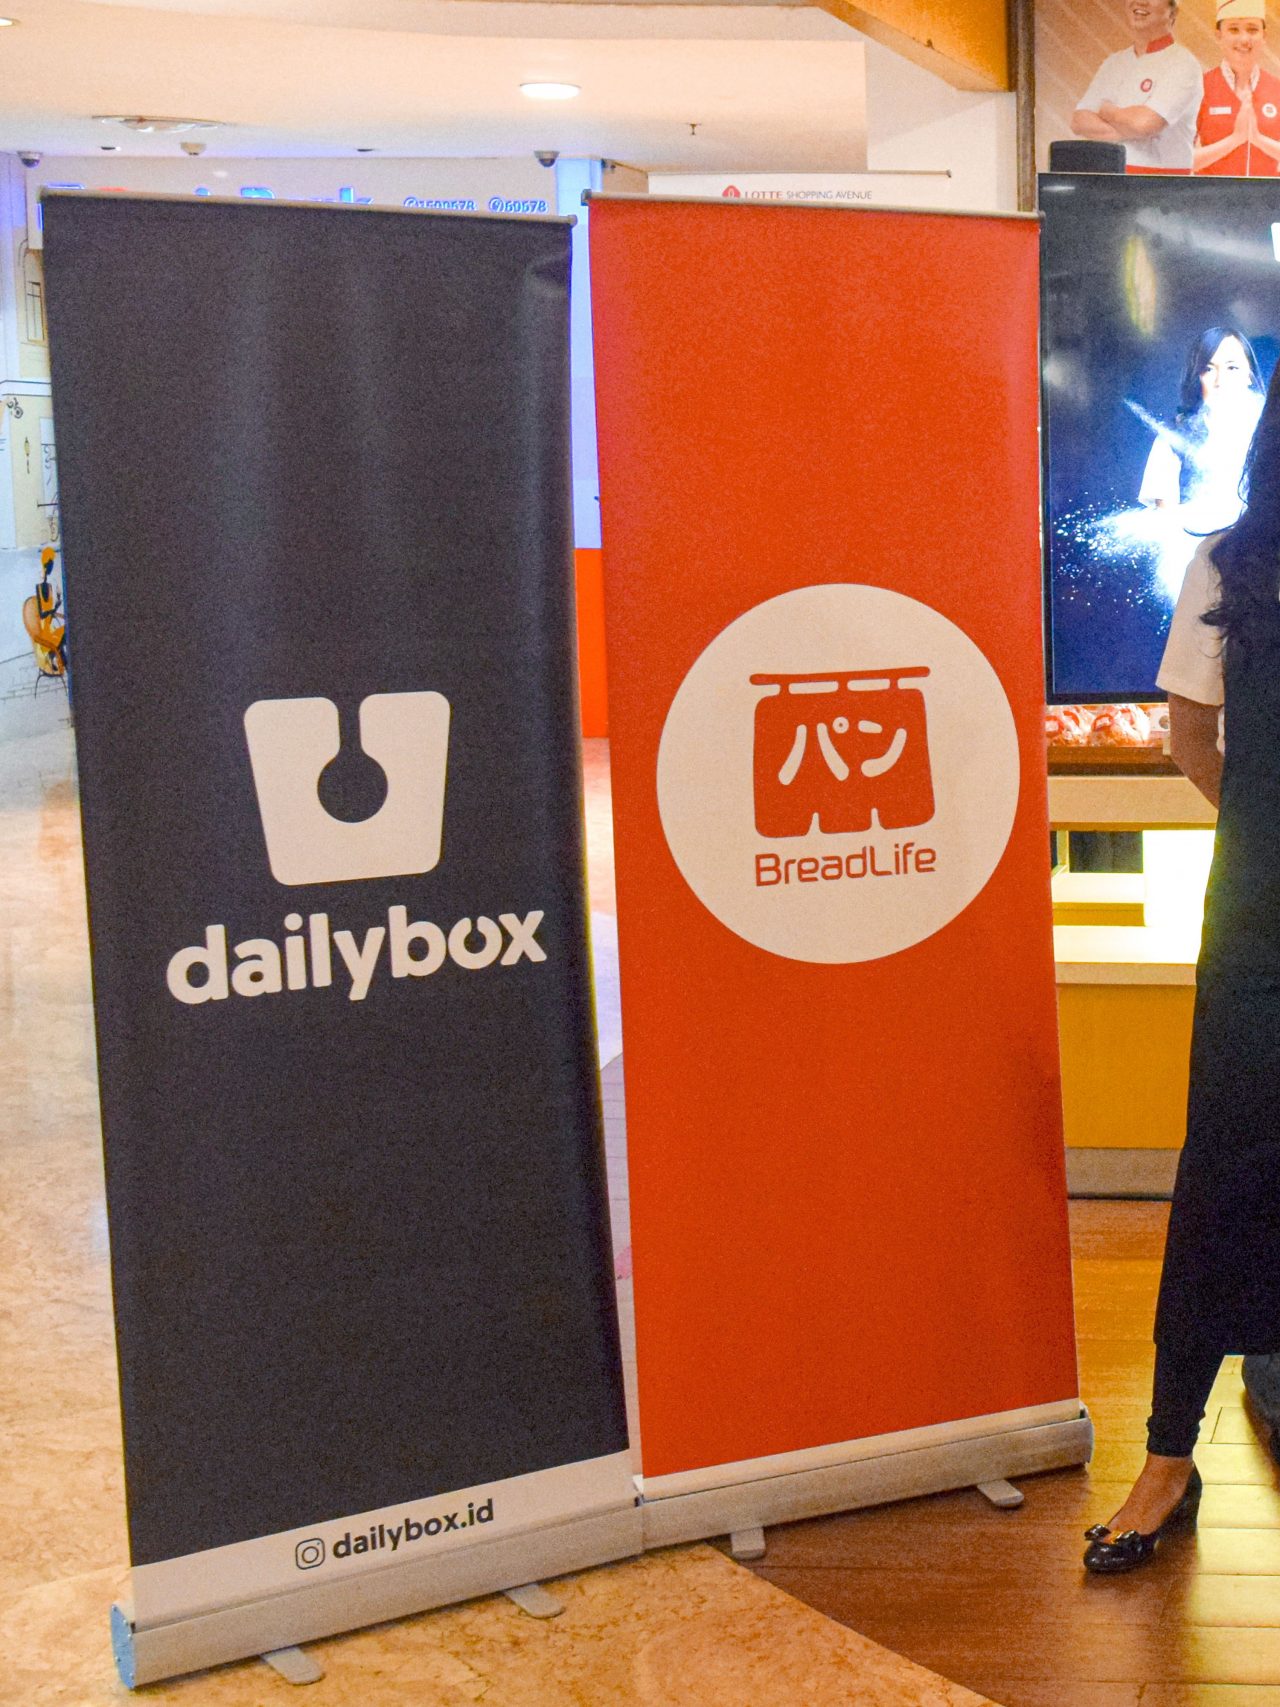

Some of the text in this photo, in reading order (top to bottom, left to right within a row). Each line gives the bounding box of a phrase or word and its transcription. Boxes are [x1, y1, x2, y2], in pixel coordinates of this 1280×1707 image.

[745, 190, 873, 200] LOTTE SHOPPING AVENUE
[778, 716, 907, 786] パン
[755, 842, 937, 887] BreadLife
[166, 904, 547, 1005] dailybox
[332, 1498, 494, 1559] dailybox.id
